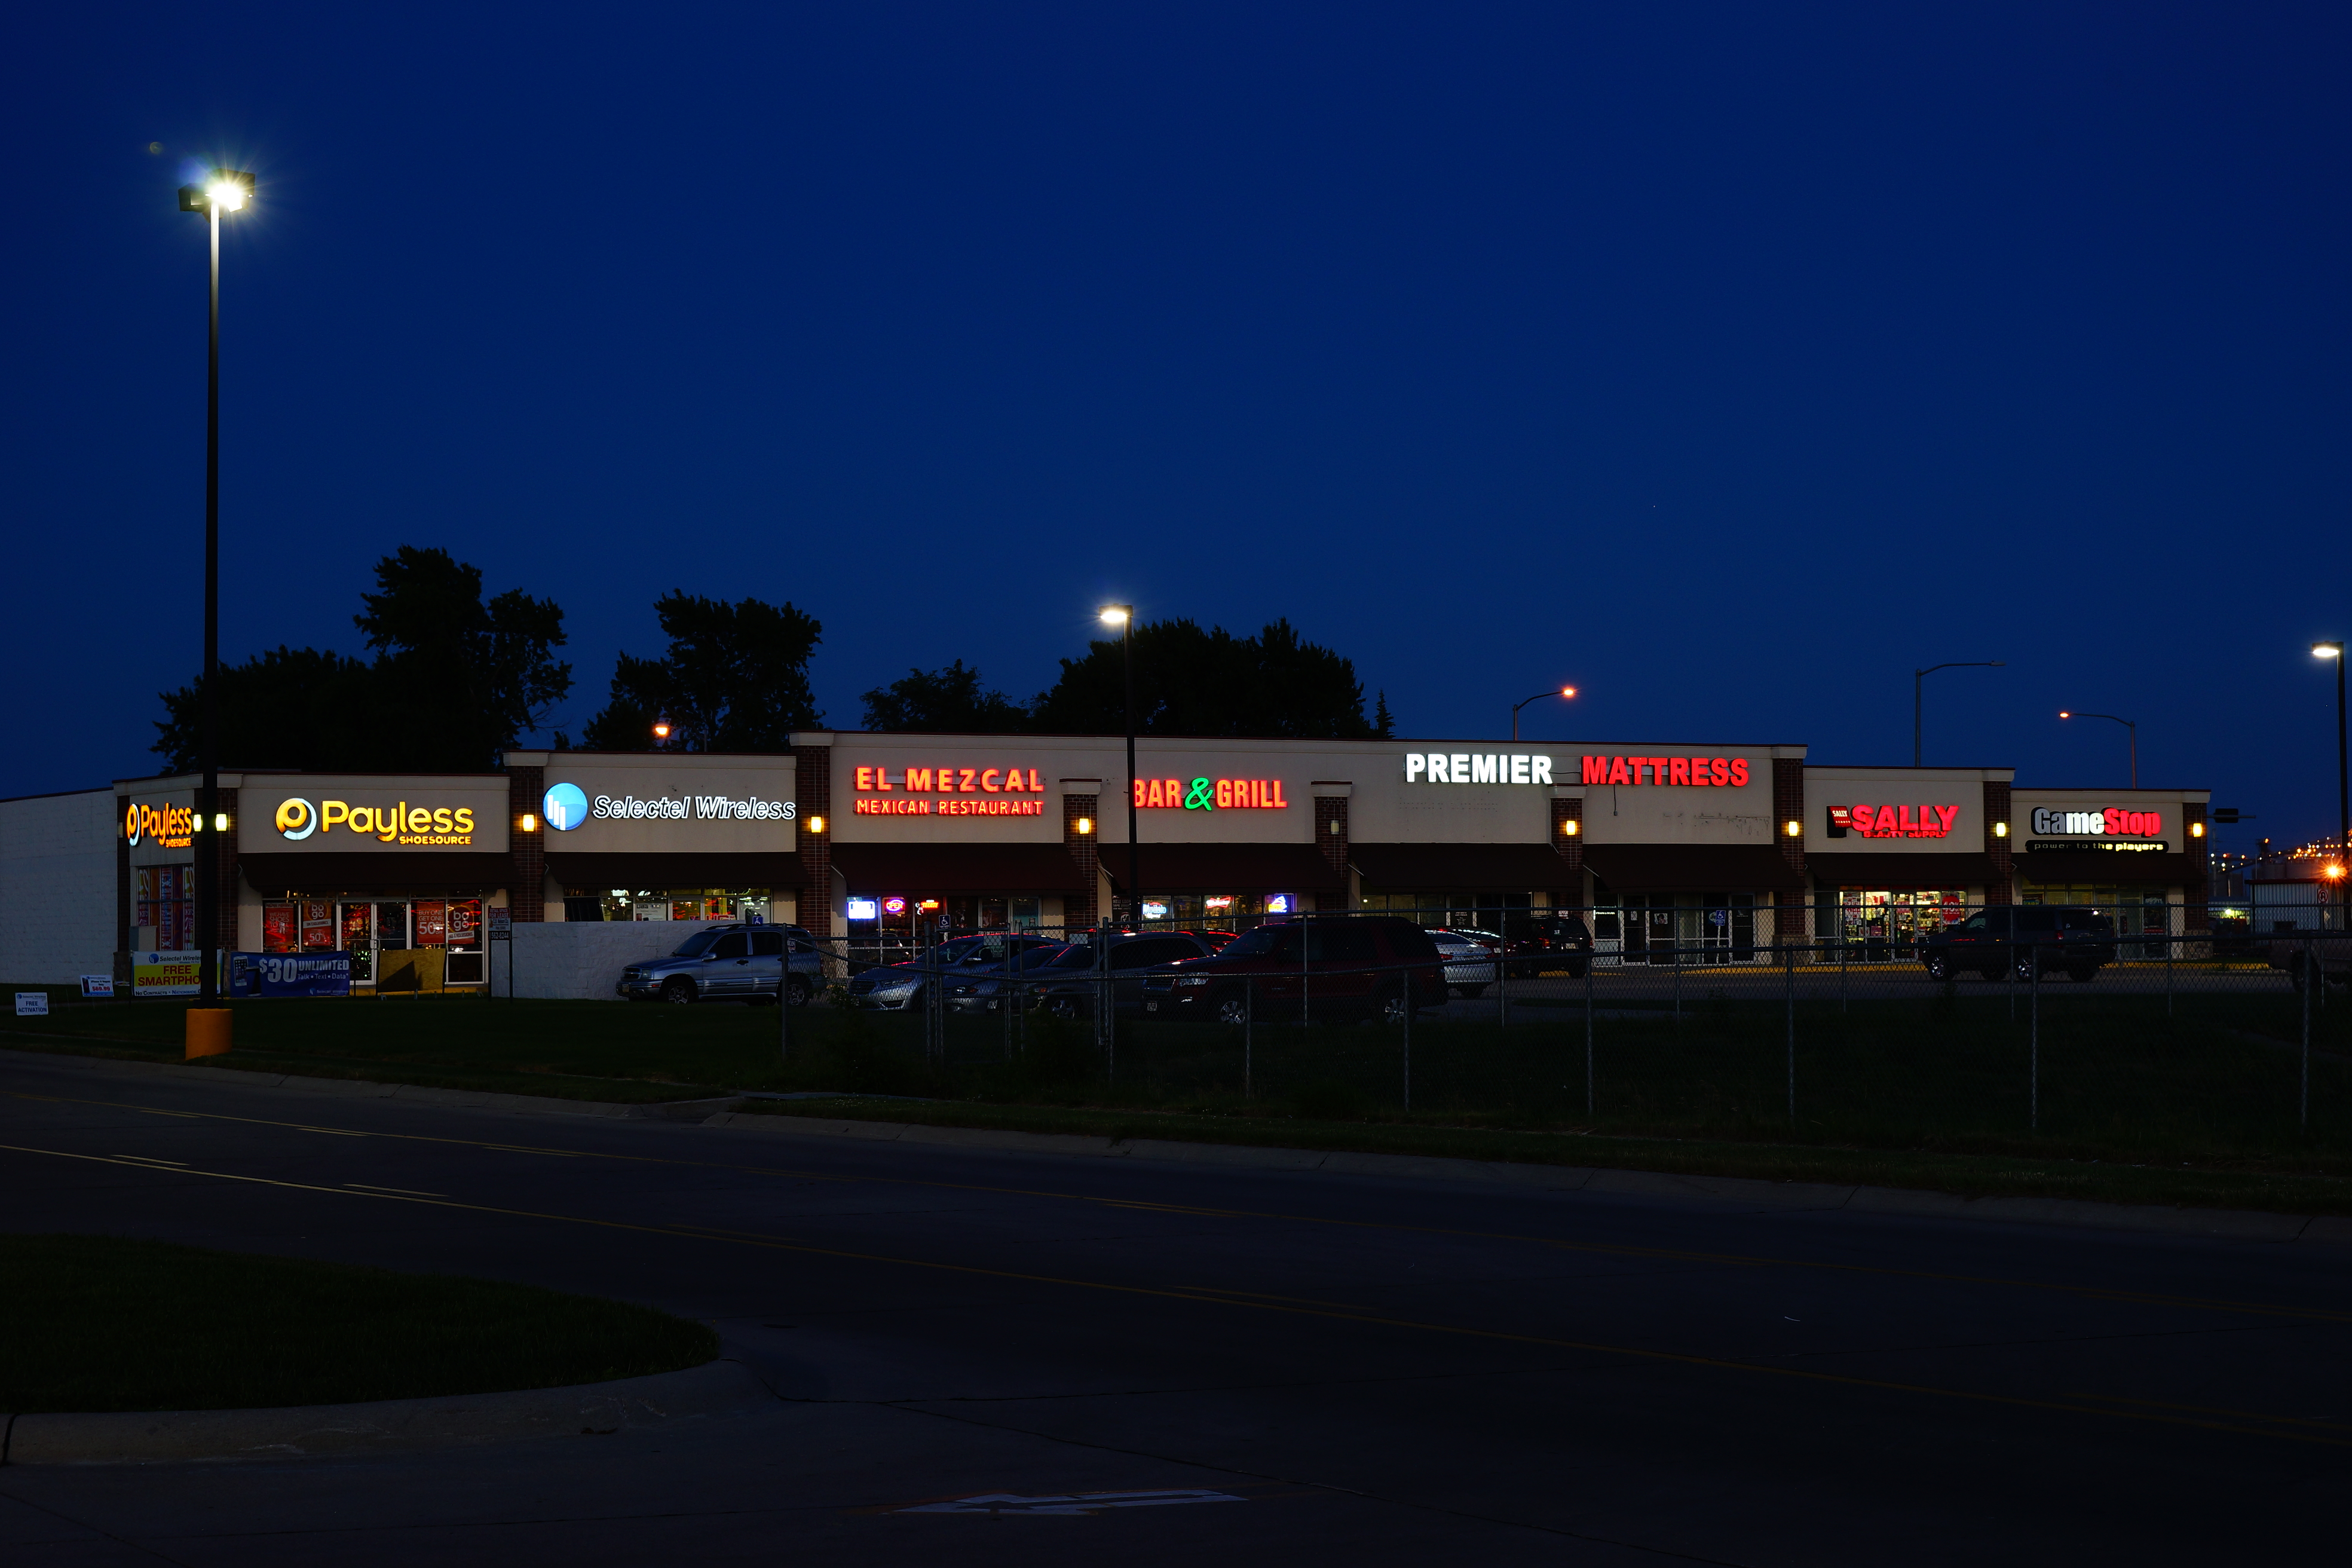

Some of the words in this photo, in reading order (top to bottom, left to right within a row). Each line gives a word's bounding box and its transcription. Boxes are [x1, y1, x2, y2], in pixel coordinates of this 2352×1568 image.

[855, 767, 892, 791] EL
[905, 768, 1044, 792] MEZCAL
[1405, 754, 1553, 784] PREMIER
[1581, 755, 1748, 787] MATTRESS
[1134, 779, 1182, 808] BAR
[1184, 777, 1214, 811] &
[1215, 779, 1288, 808] GRILL
[592, 795, 691, 819] Selectel
[695, 795, 796, 820] Wireless
[855, 800, 930, 814] MEXICAN
[937, 800, 1044, 814] RESTAURANT
[1851, 805, 1959, 832] SALLY
[140, 802, 192, 846] Payless
[321, 800, 475, 842] Payless
[2033, 807, 2161, 837] GameStop
[166, 837, 191, 848] SHOESOURCE
[399, 835, 472, 845] SHOESOURCE
[2115, 842, 2164, 852] players
[138, 975, 202, 986] SMARTPHO
[163, 965, 192, 975] FREE
[259, 958, 298, 983] $30
[298, 959, 350, 971] UNLIMITED
